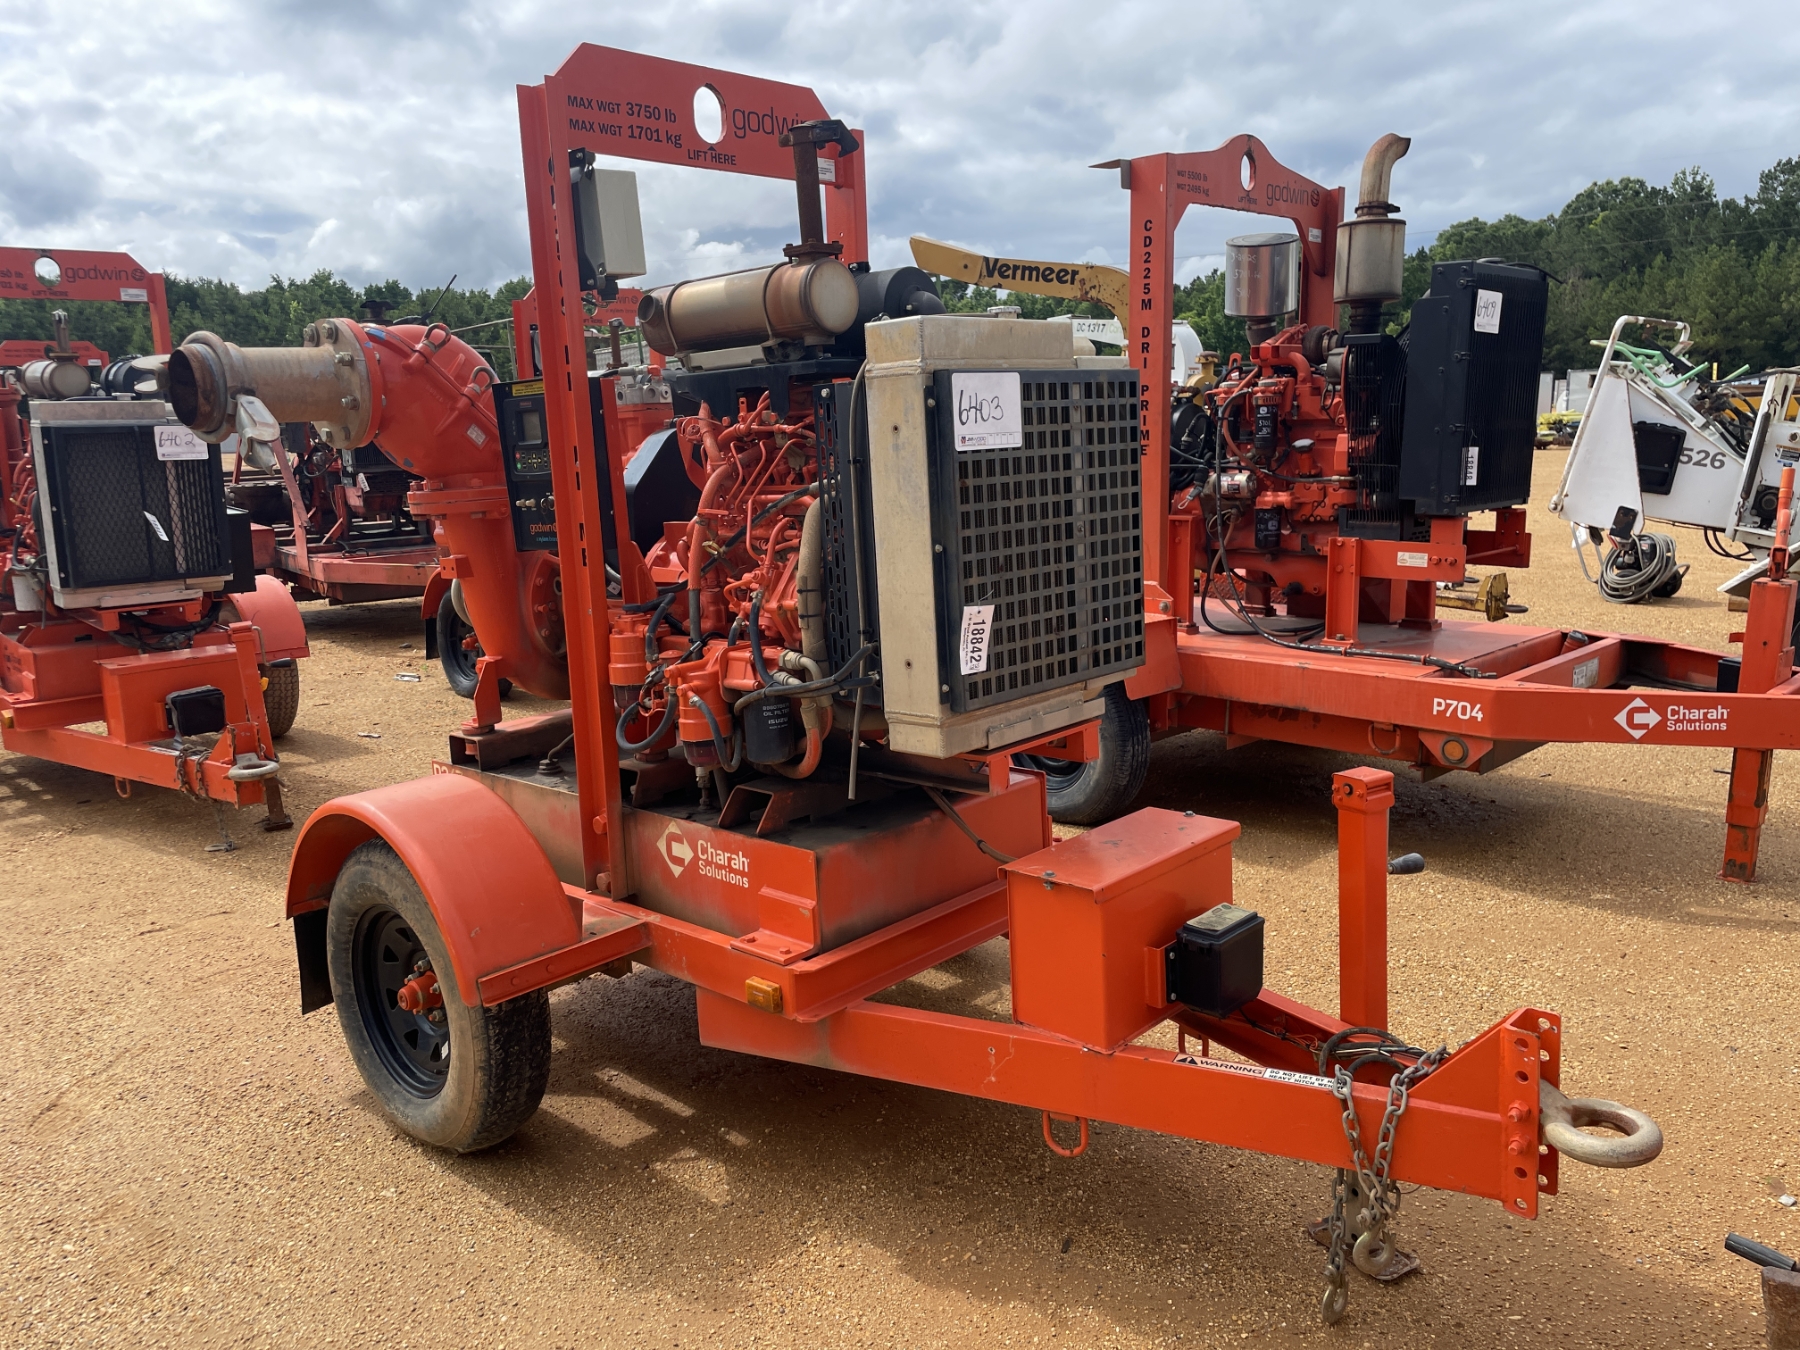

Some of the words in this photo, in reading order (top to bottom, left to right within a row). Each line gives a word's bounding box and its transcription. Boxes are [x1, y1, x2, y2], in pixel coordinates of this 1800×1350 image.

[567, 94, 594, 110] MAX
[596, 99, 621, 114] WGT
[626, 102, 661, 121] 3750
[664, 108, 677, 124] lb
[569, 118, 596, 133] MAX
[597, 122, 623, 137] WGT
[627, 124, 663, 143] 1701
[665, 130, 682, 148] kg
[732, 106, 806, 139] godwi
[687, 148, 708, 163] LIFT
[710, 151, 737, 166] HERE
[1187, 170, 1202, 181] 5500
[1202, 187, 1210, 197] kg
[1266, 183, 1309, 206] godwin
[65, 265, 129, 283] godwin
[983, 256, 1080, 285] Vermeer
[1141, 219, 1153, 311] CD225M
[1477, 296, 1497, 319] 6409
[1141, 326, 1150, 369] DRI
[958, 389, 1004, 426] 6403
[1140, 384, 1150, 456] PRIME
[158, 431, 196, 449] 6402
[1679, 446, 1727, 470] 526
[530, 522, 554, 535] godwin
[970, 619, 987, 663] 18842
[1432, 697, 1484, 722] P704
[1667, 705, 1729, 720] Charah
[1667, 720, 1727, 732] Solutions
[697, 839, 748, 873] Charah
[698, 860, 749, 888] Solutions
[1200, 1060, 1262, 1074] WARNING
